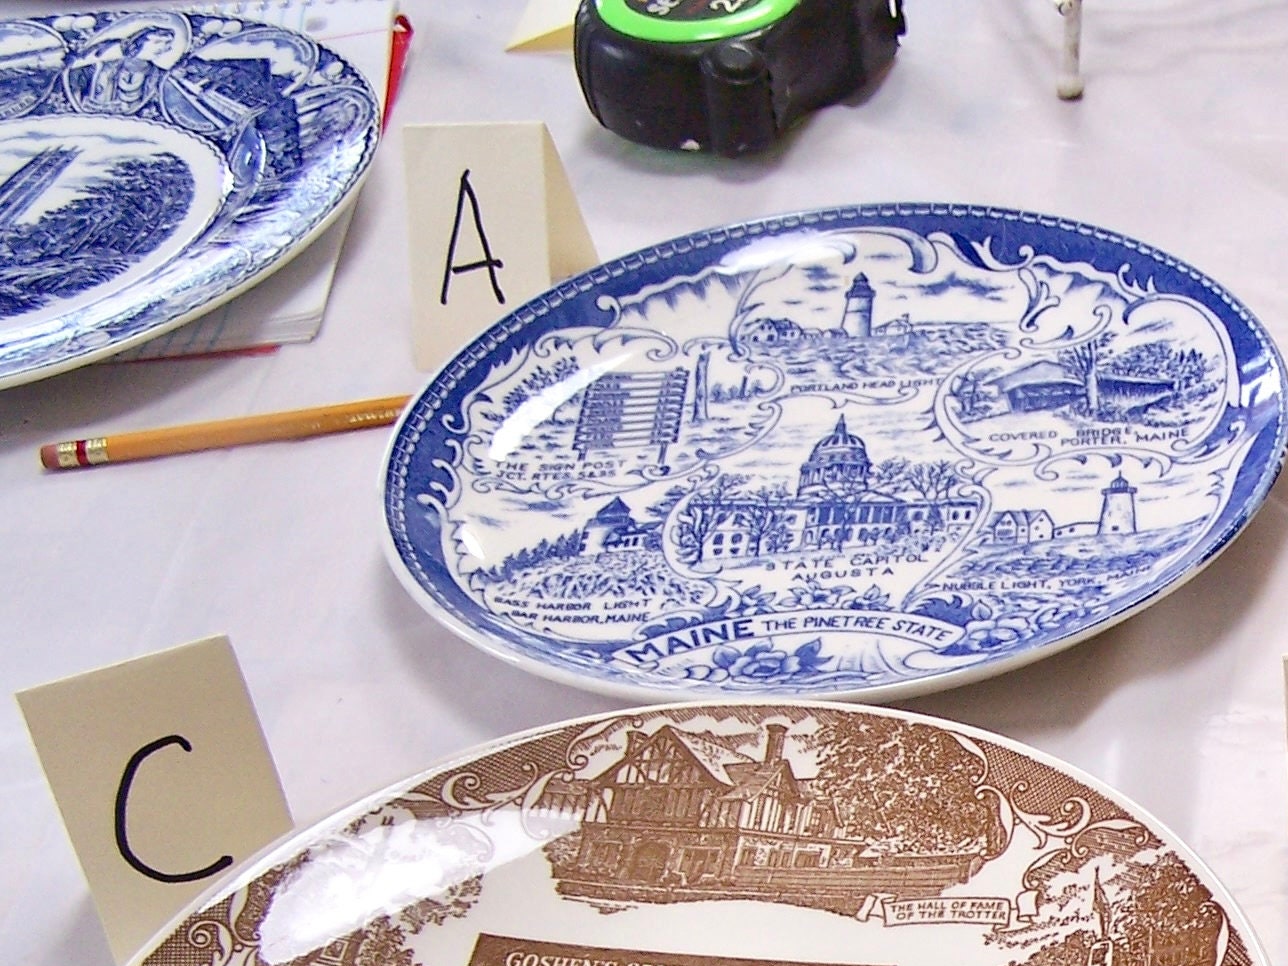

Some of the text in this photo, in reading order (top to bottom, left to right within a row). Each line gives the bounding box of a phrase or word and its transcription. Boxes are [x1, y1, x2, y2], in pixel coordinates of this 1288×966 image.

[440, 168, 506, 305] A
[790, 377, 946, 393] PORTLAND HEAD LIGHT
[988, 430, 1058, 443] COVERED
[1135, 427, 1190, 443] MAINE
[495, 460, 627, 471] THE SIGN POST
[765, 553, 929, 571] STATE CAPITOL
[791, 566, 895, 582] AUGUSTA
[942, 580, 996, 592] NUBBLE
[536, 601, 592, 611] HARBOR
[603, 597, 650, 610] LIGHT
[511, 609, 538, 620] BAR
[606, 611, 652, 624] MAINE
[625, 619, 755, 664] MAINE
[761, 618, 798, 632] THE
[892, 618, 953, 642] STATE
[115, 734, 233, 884] C
[890, 901, 1006, 913] THE HALL OF FAME
[895, 911, 1007, 921] OF THE TROTTER
